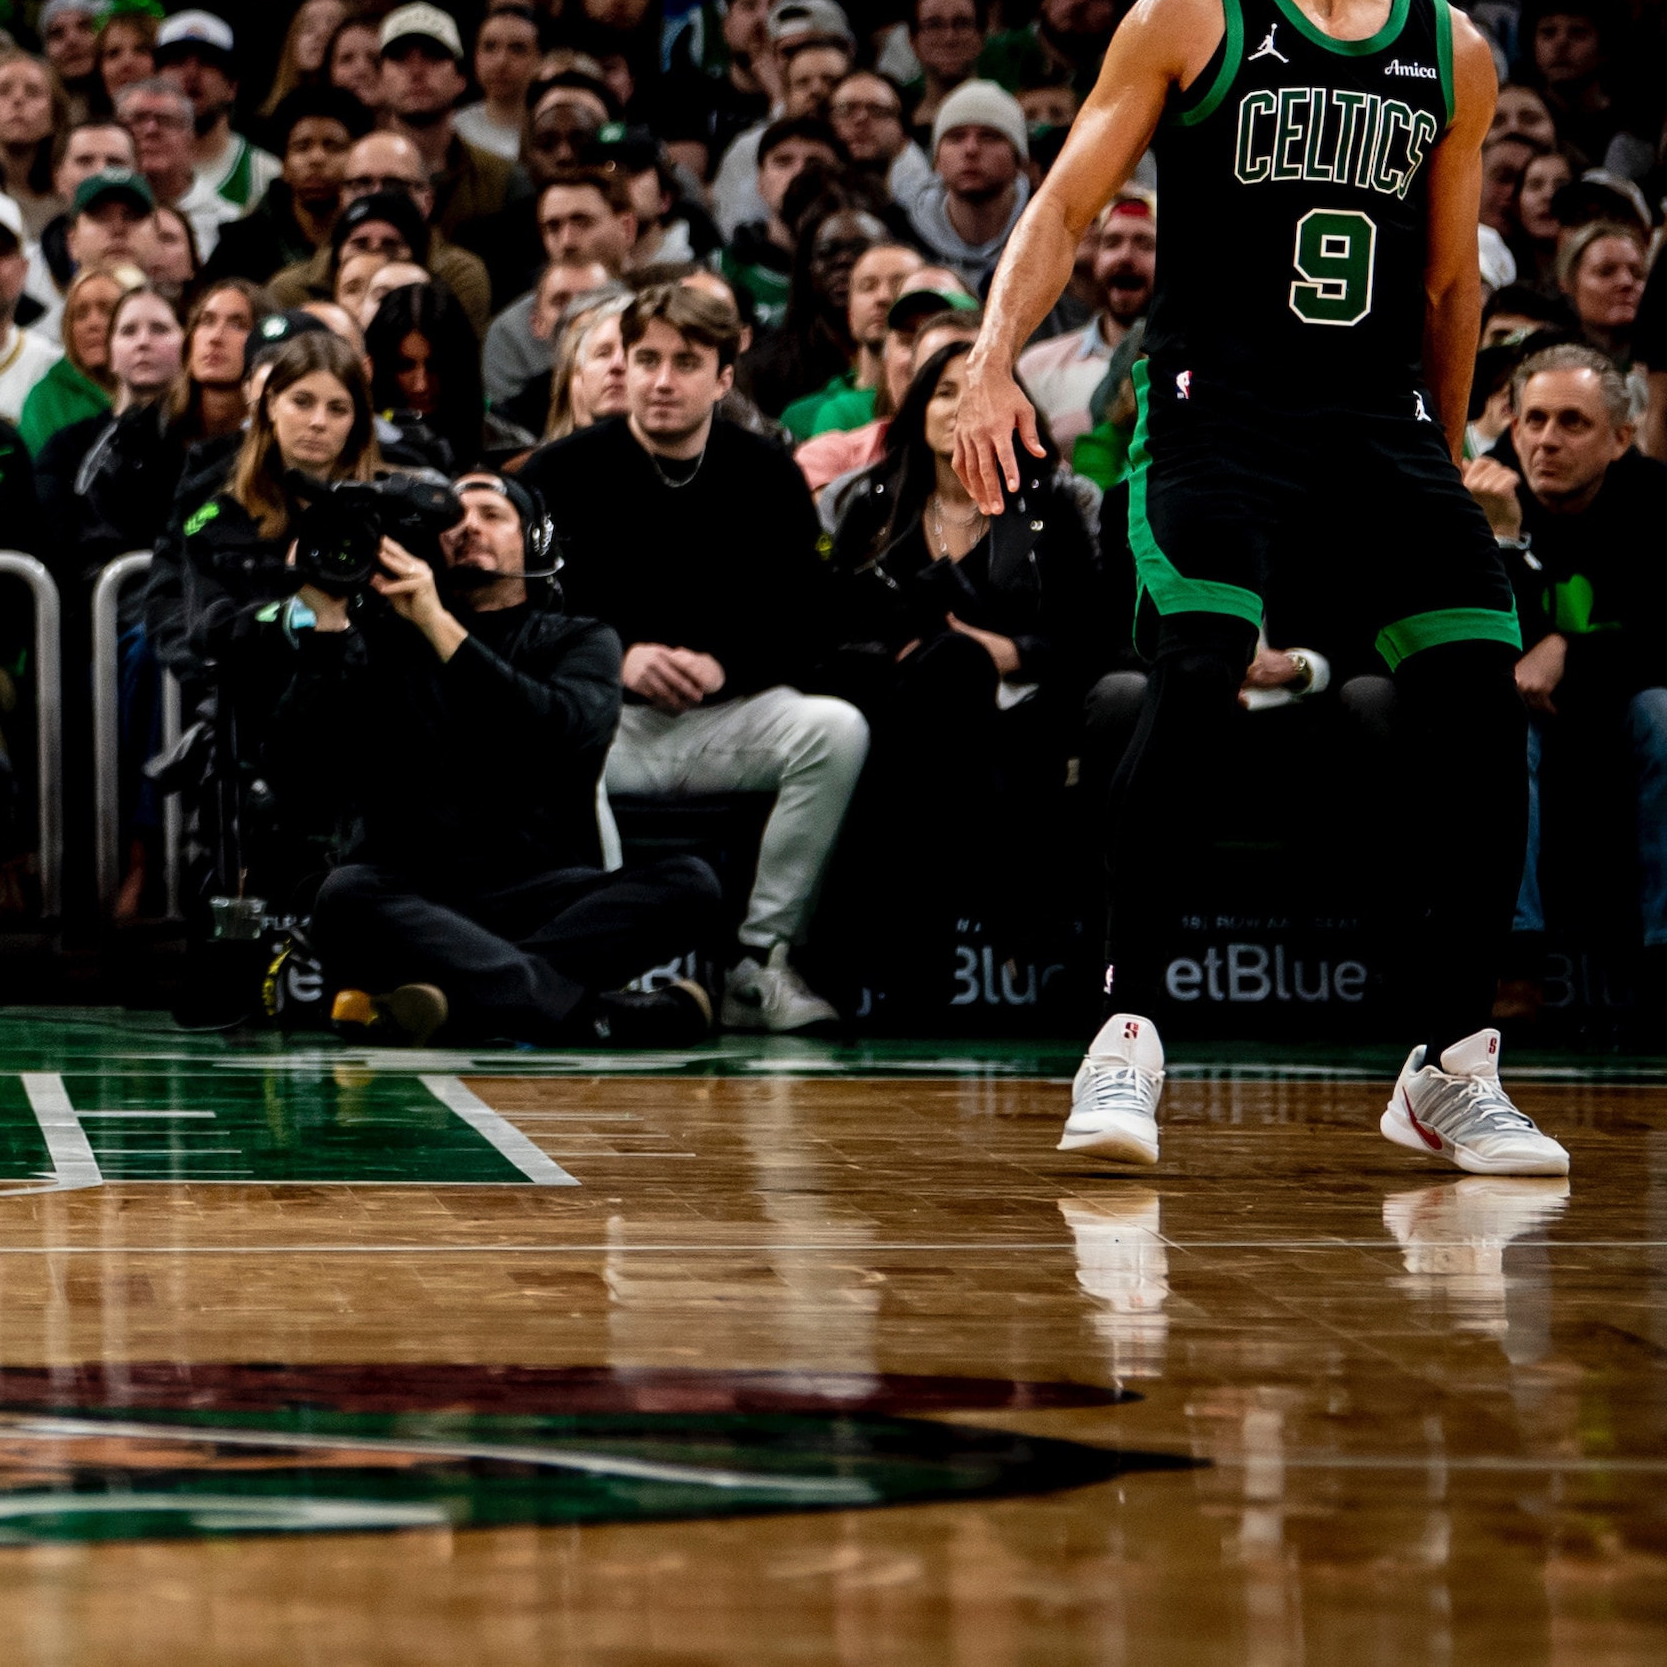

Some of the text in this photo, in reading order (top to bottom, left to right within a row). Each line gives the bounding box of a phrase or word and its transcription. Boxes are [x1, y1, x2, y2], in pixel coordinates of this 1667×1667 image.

[1384, 59, 1438, 80] Amica
[1234, 86, 1438, 201] CELTICS
[1289, 208, 1378, 327] 9
[1166, 941, 1369, 1003] etBlue
